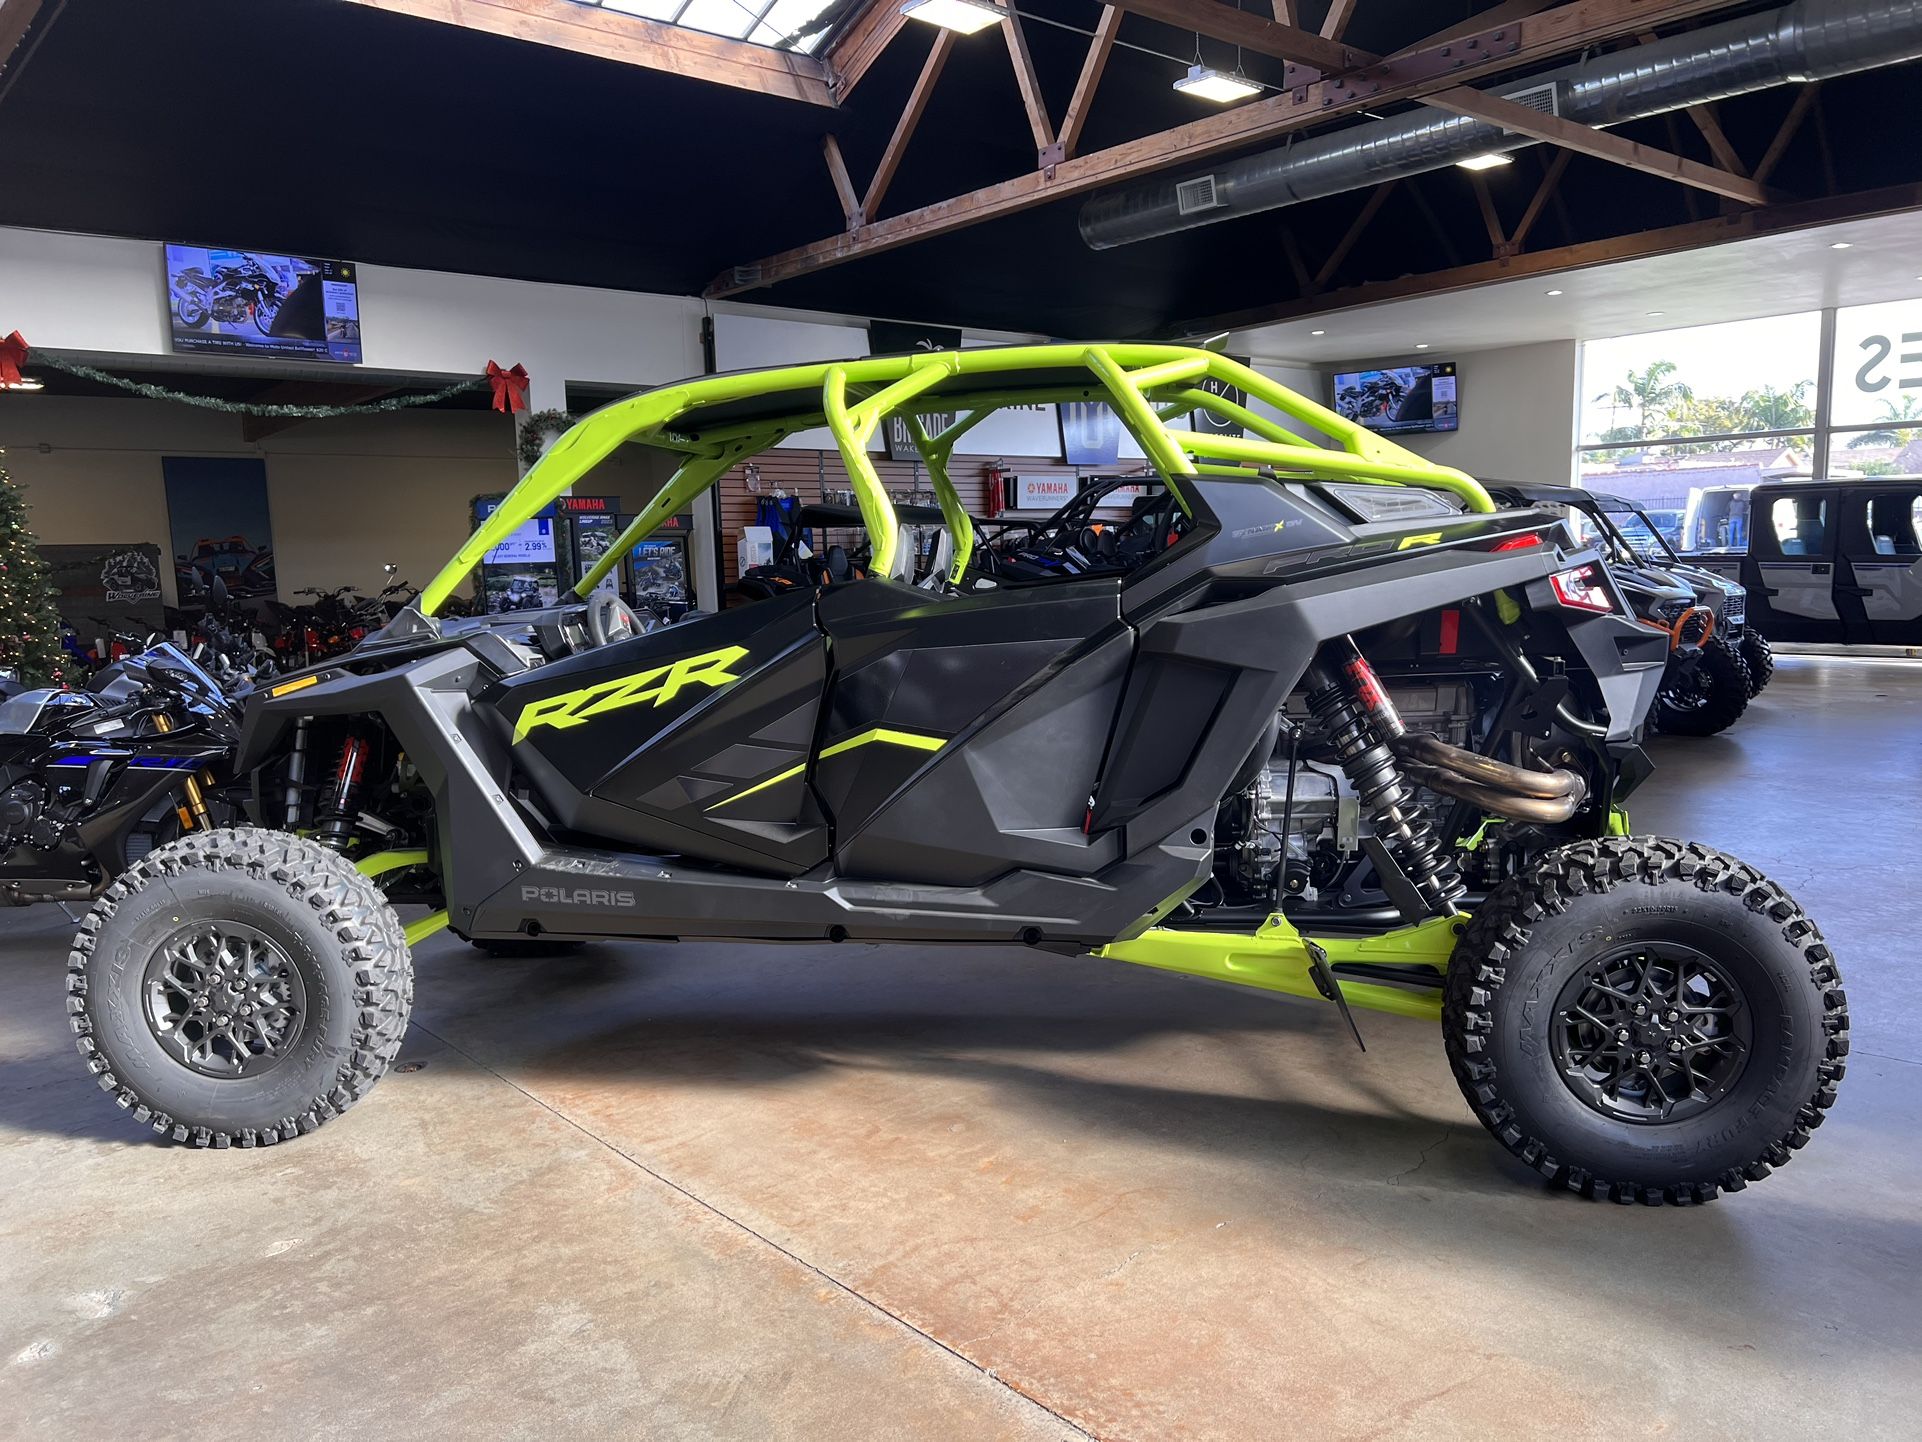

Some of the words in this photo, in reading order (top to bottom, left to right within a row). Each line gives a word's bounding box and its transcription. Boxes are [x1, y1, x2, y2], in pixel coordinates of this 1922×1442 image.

[1036, 482, 1069, 494] YAMAHA
[566, 498, 605, 510] YAMAHA
[512, 645, 750, 746] RZR
[520, 885, 637, 907] POLARIS
